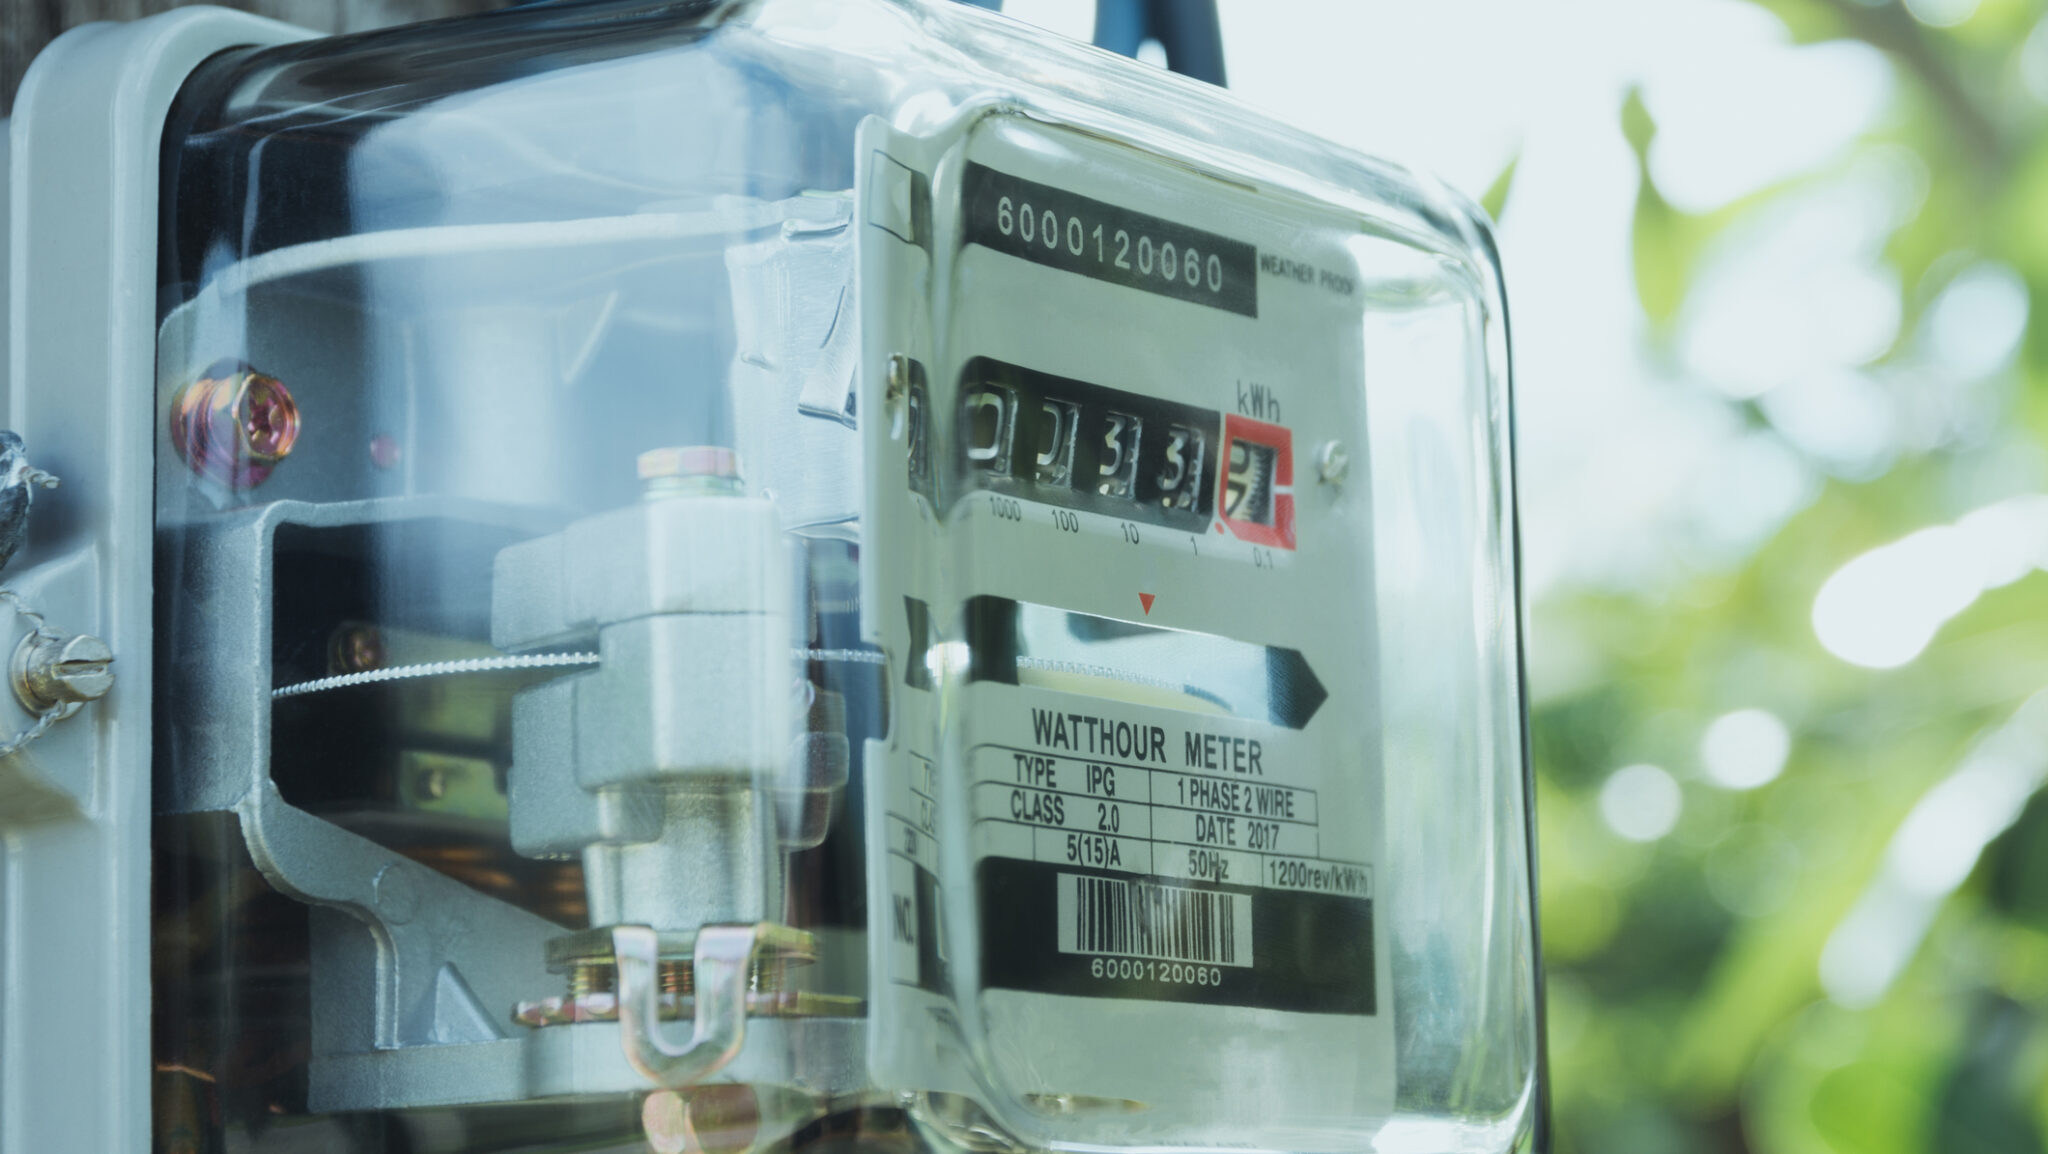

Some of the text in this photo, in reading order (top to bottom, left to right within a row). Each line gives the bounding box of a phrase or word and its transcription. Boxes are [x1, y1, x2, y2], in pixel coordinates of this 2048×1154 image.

[997, 196, 1223, 293] 6000120060
[1260, 254, 1315, 285] WEATHER
[1236, 379, 1281, 423] kWh
[990, 497, 1273, 569] 1000 100 10 1 0.1
[1032, 708, 1263, 776] WATTHOUR METER
[1013, 753, 1295, 818] TYPE IPG 1 PHASE 2 WIRE
[1010, 789, 1280, 850] CLASS 2.0 DATE 2017
[1067, 834, 1367, 894] 5(15)A 50Hz 1200rev/kWh
[1091, 958, 1221, 986] 6000120060
